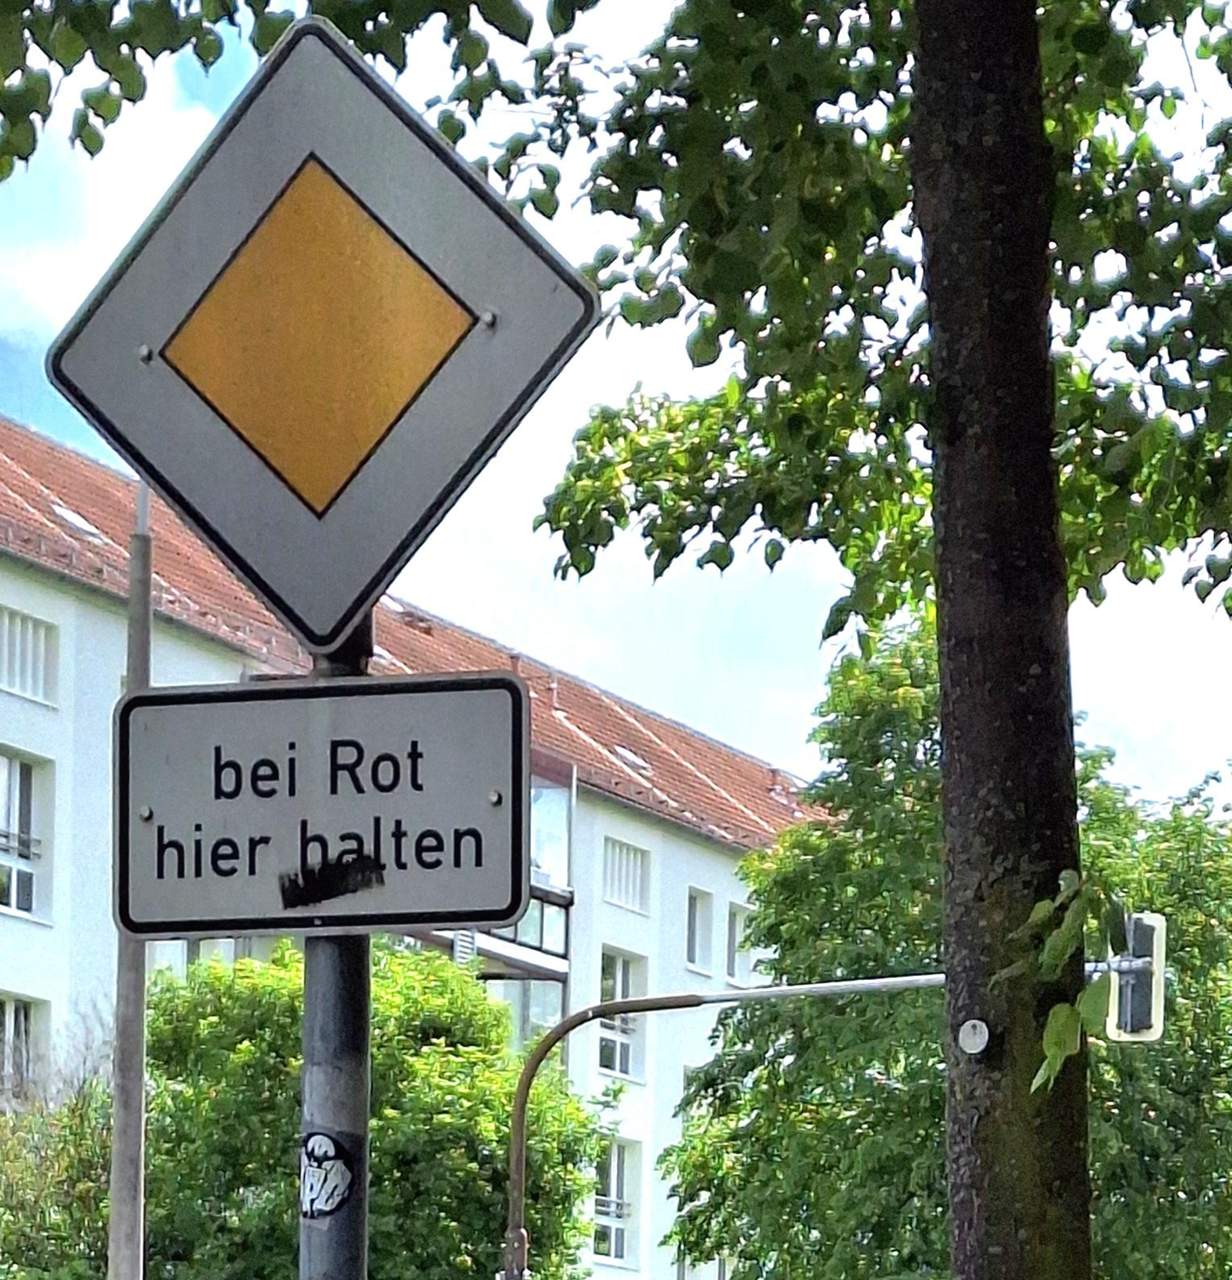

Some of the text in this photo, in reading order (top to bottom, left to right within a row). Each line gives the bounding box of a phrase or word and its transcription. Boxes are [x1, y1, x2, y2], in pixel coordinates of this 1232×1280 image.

[213, 739, 424, 800] bei Rot
[156, 815, 484, 879] hier halten
